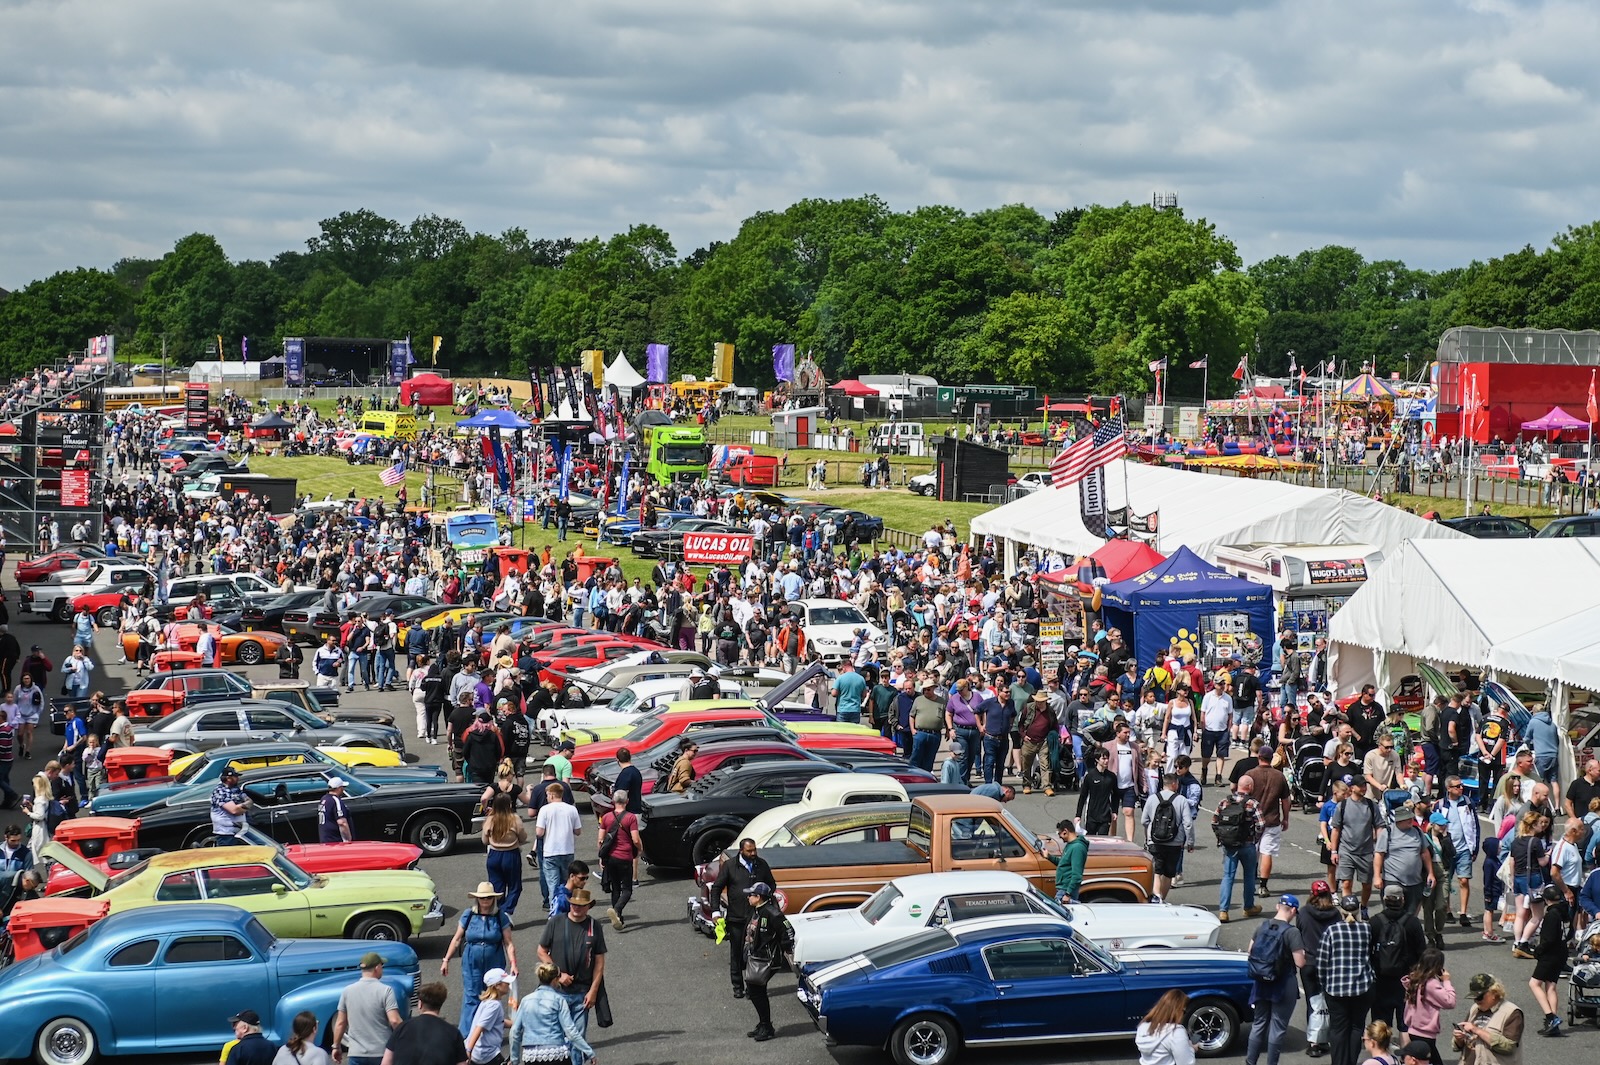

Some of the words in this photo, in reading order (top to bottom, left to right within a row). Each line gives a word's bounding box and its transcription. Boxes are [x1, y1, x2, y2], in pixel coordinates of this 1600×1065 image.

[685, 536, 728, 551] LUCAS
[730, 537, 750, 552] OIL
[1311, 569, 1337, 578] HUGO'S
[1337, 568, 1365, 577] PLATES
[1202, 597, 1223, 605] amazing
